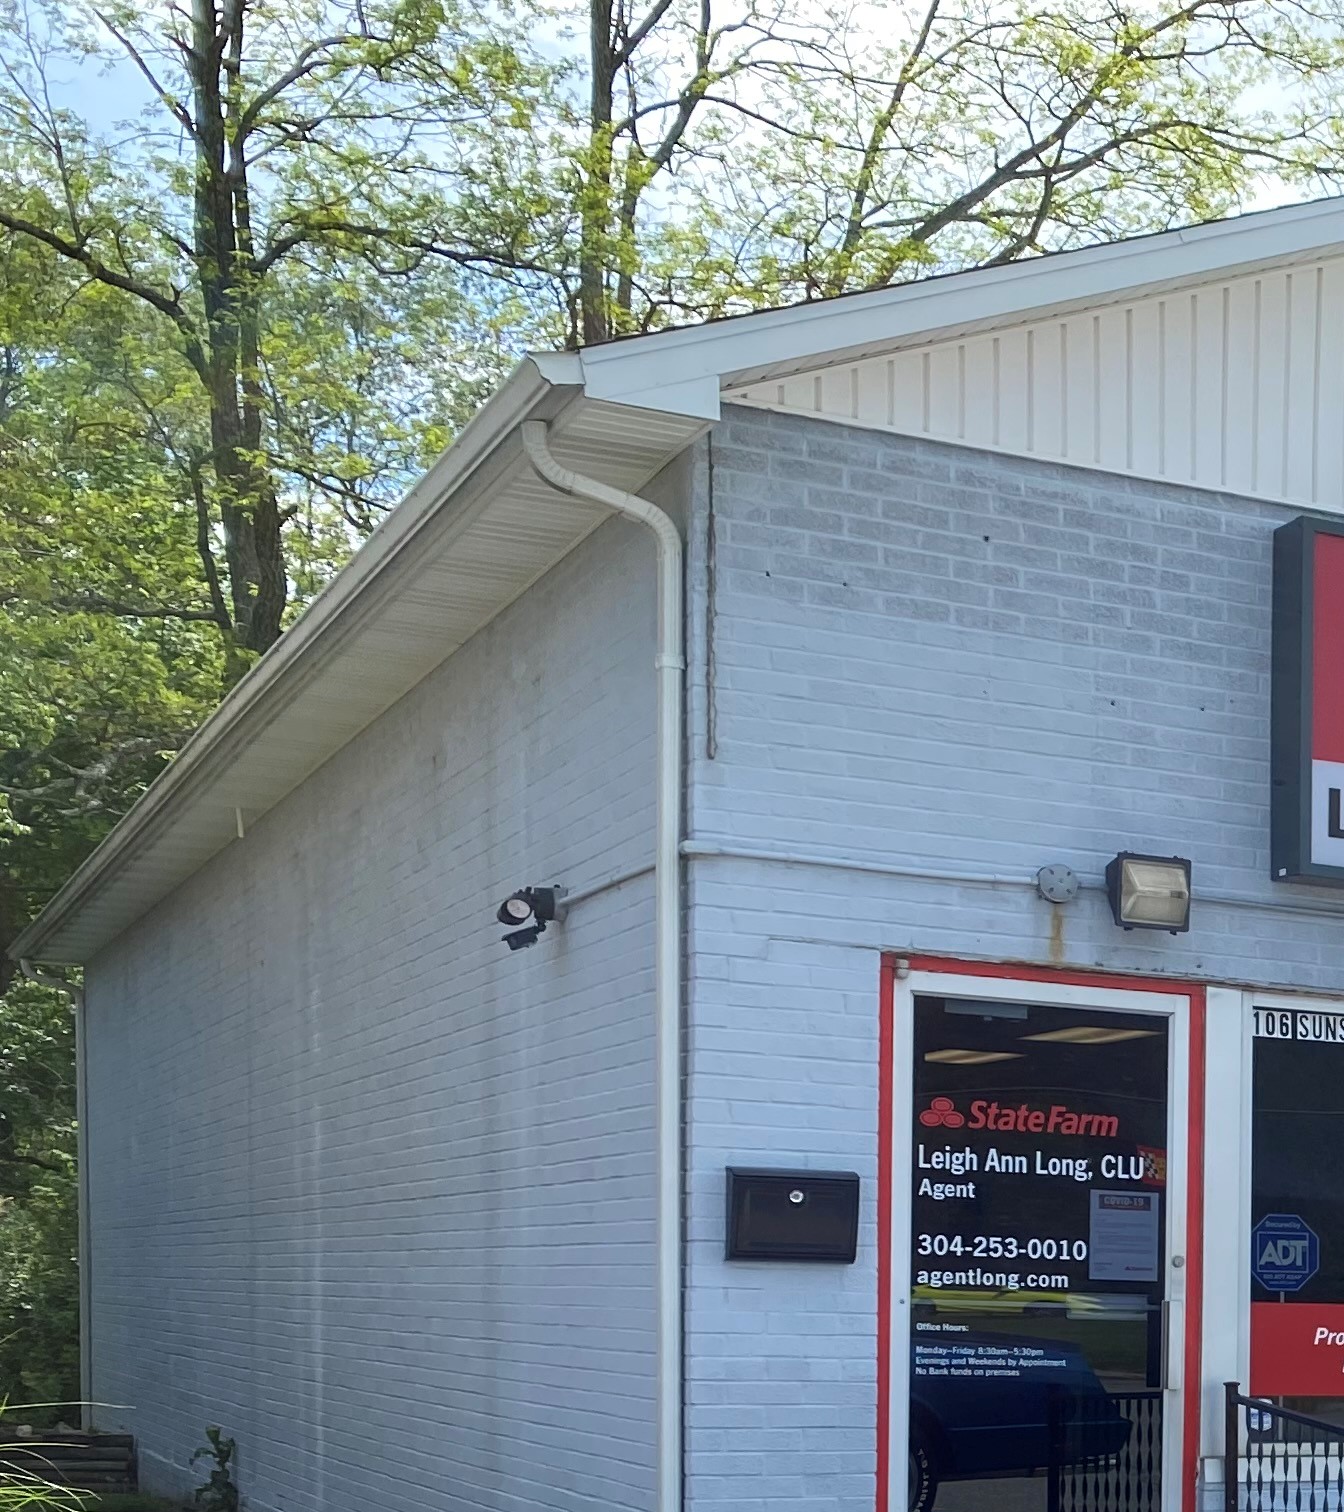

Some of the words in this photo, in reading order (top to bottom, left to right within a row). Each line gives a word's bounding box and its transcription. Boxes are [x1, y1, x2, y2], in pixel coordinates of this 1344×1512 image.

[1253, 1011, 1289, 1037] 106
[918, 1144, 978, 1175] Leigh
[984, 1148, 1027, 1174] Ann
[1036, 1150, 1093, 1181] Long,
[1101, 1154, 1144, 1180] CLU
[918, 1178, 976, 1200] Agent
[917, 1234, 1087, 1261] 304-253-0010
[1259, 1240, 1308, 1266] ADT
[917, 1268, 1069, 1289] agentlong.com
[916, 1322, 941, 1332] Office
[943, 1323, 969, 1332] Hours:
[915, 1367, 926, 1375] No
[929, 1367, 948, 1376] Bank
[950, 1368, 972, 1376] funds
[968, 1358, 1006, 1366] Weekends
[1018, 1359, 1066, 1367] Appointment
